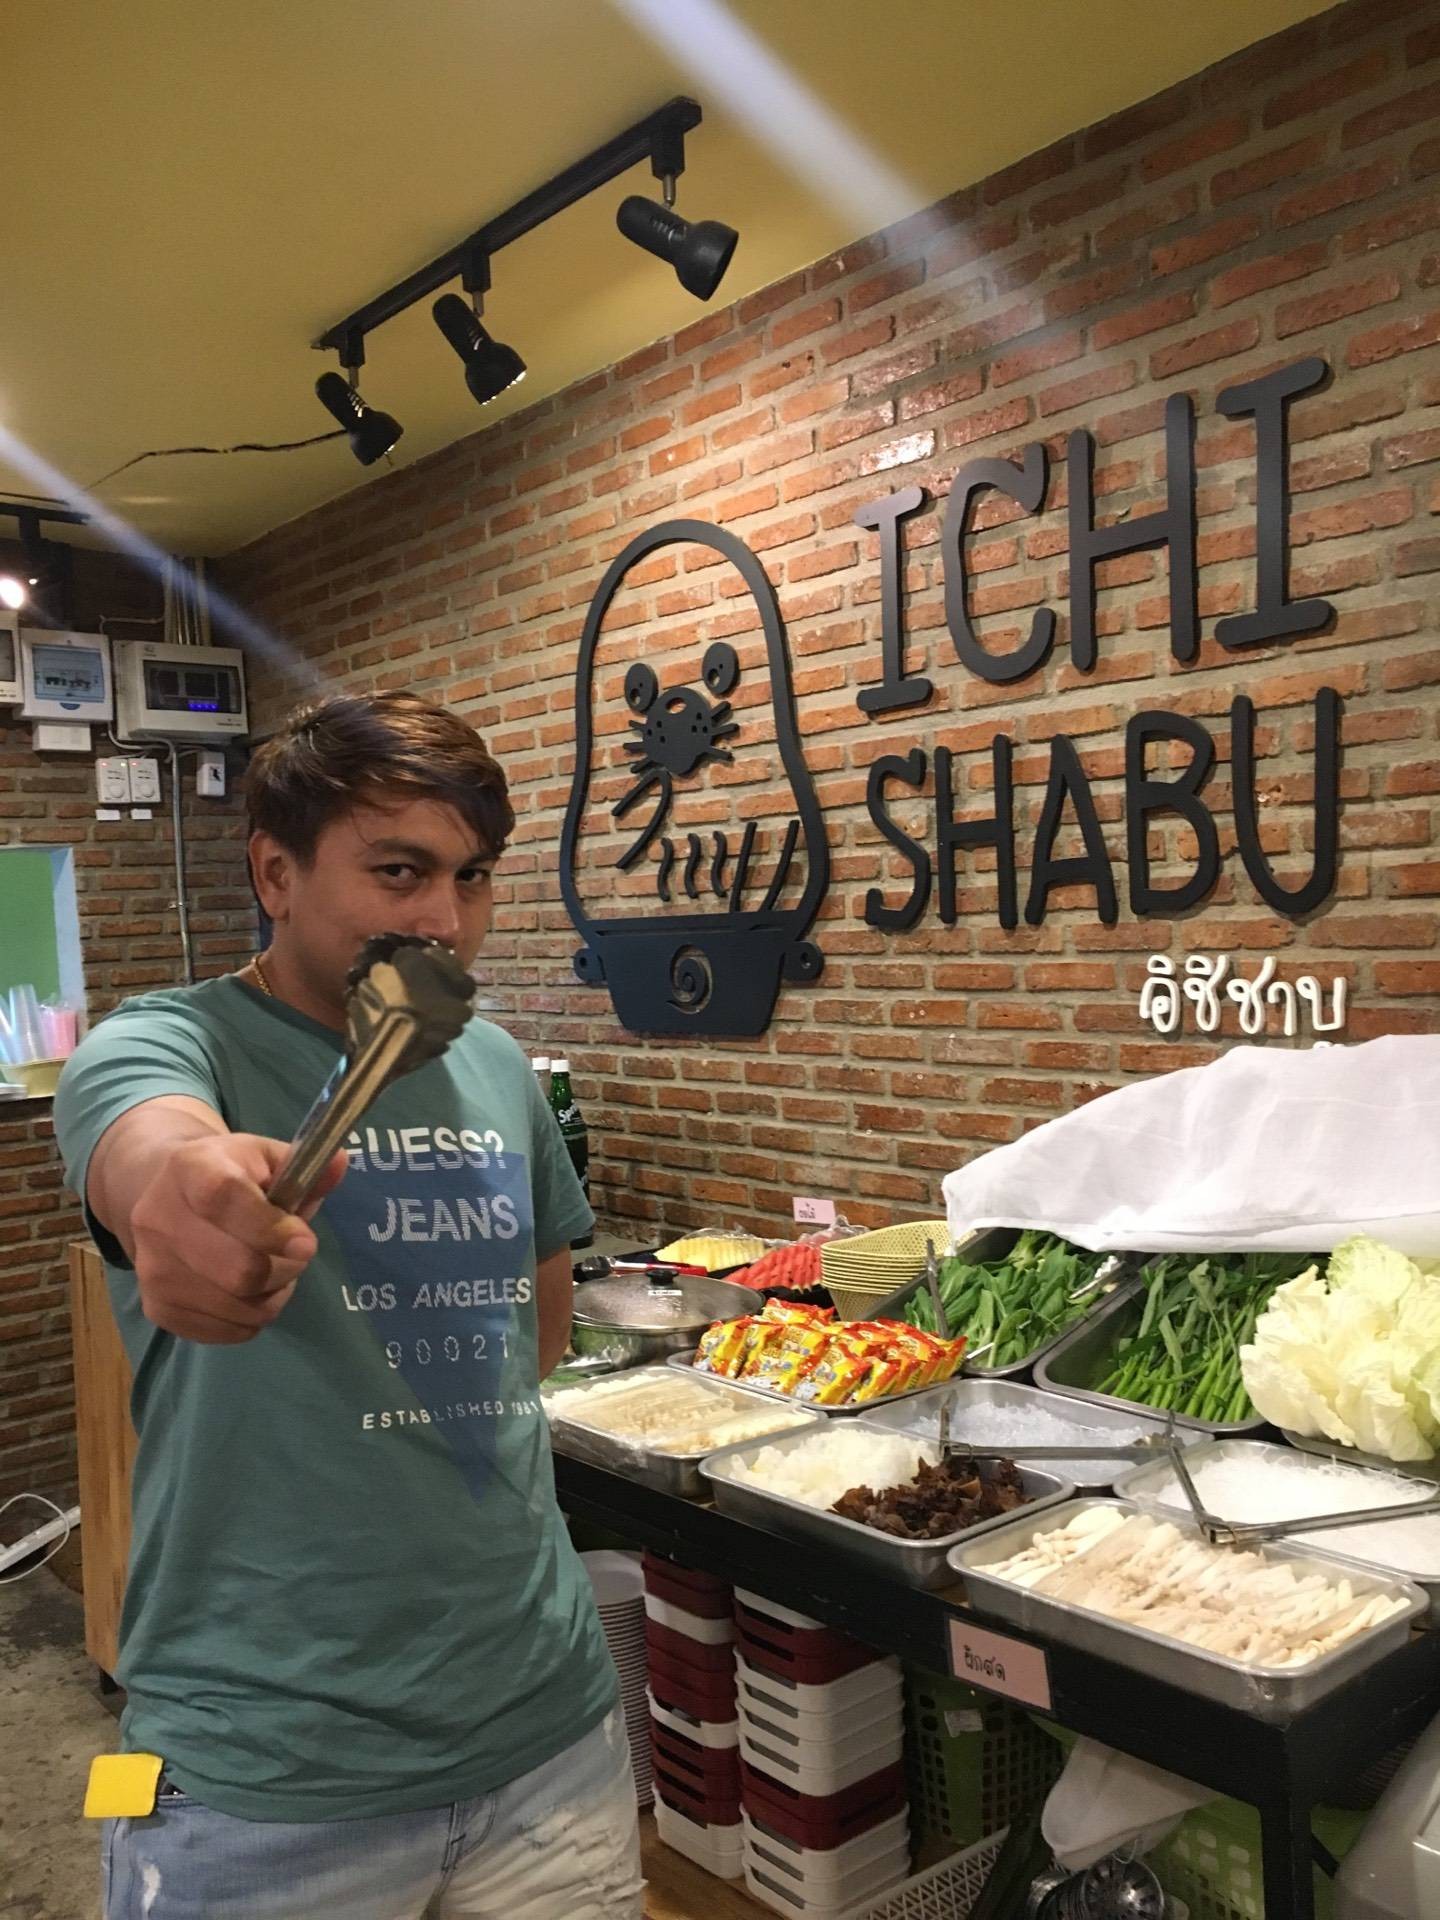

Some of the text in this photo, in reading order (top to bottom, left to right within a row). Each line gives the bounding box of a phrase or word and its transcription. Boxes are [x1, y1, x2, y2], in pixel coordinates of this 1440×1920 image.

[854, 357, 1336, 713] ICHI
[865, 687, 1340, 930] SHABU
[1139, 954, 1347, 1047] อิชิชาบ
[368, 1195, 519, 1242] JEANS
[341, 1277, 531, 1311] LOS ANGELES
[386, 1331, 508, 1369] 90021
[362, 1401, 504, 1430] ESTABLISHED
